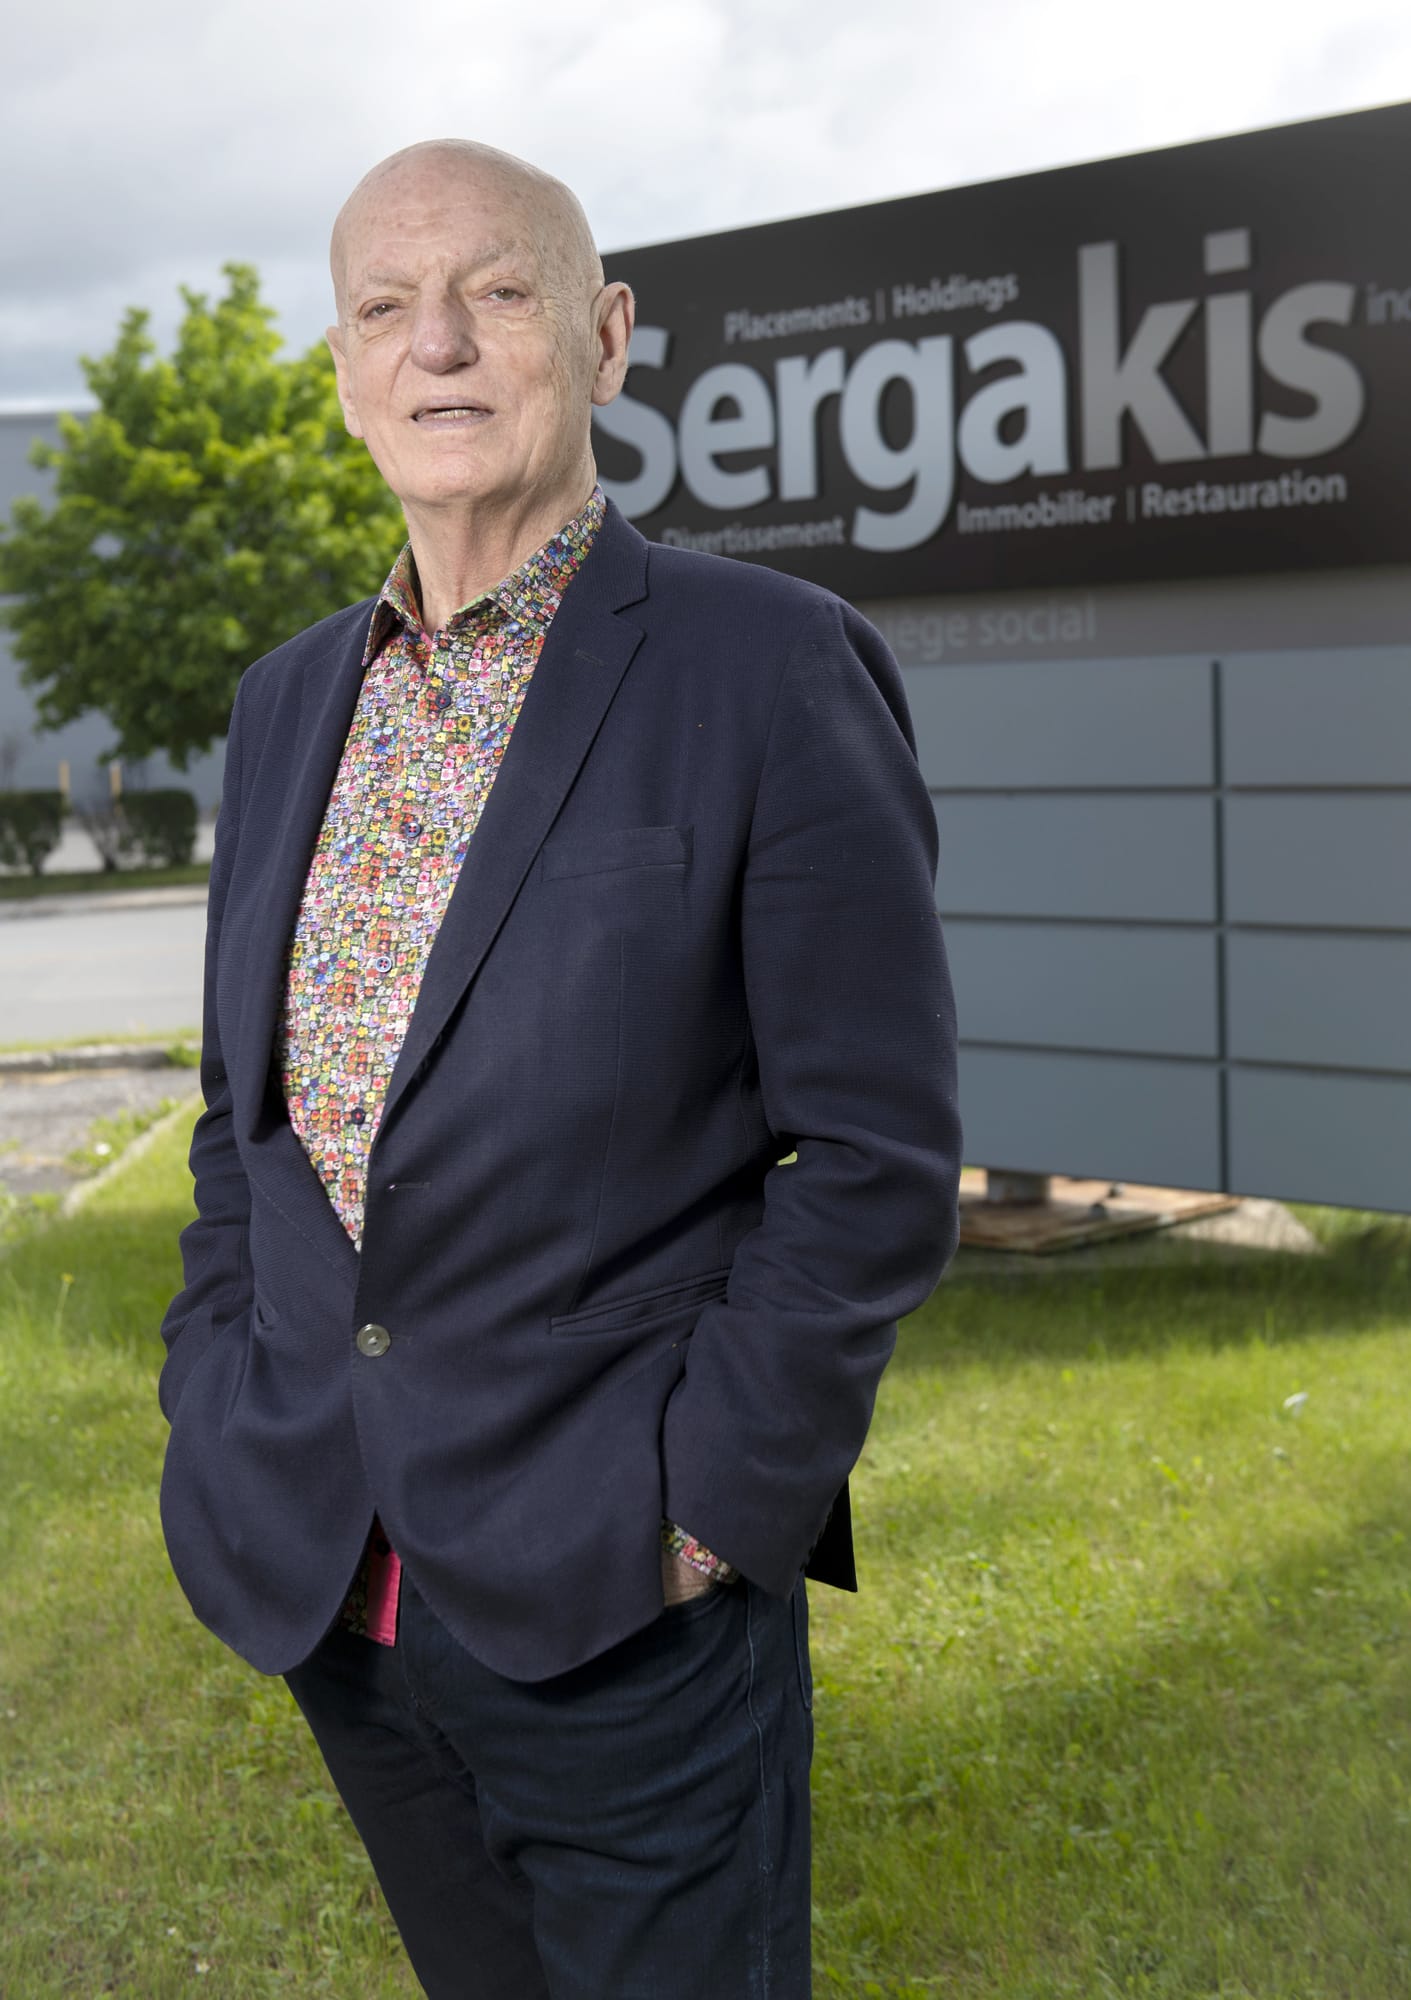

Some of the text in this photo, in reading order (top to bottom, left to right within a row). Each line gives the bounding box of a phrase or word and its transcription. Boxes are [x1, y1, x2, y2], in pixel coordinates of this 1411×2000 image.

[724, 273, 1019, 343] Placements Holdings
[591, 227, 1366, 552] Sergakis
[661, 469, 1348, 554] Divertissement Immobilier Restauration
[977, 592, 1098, 647] social
